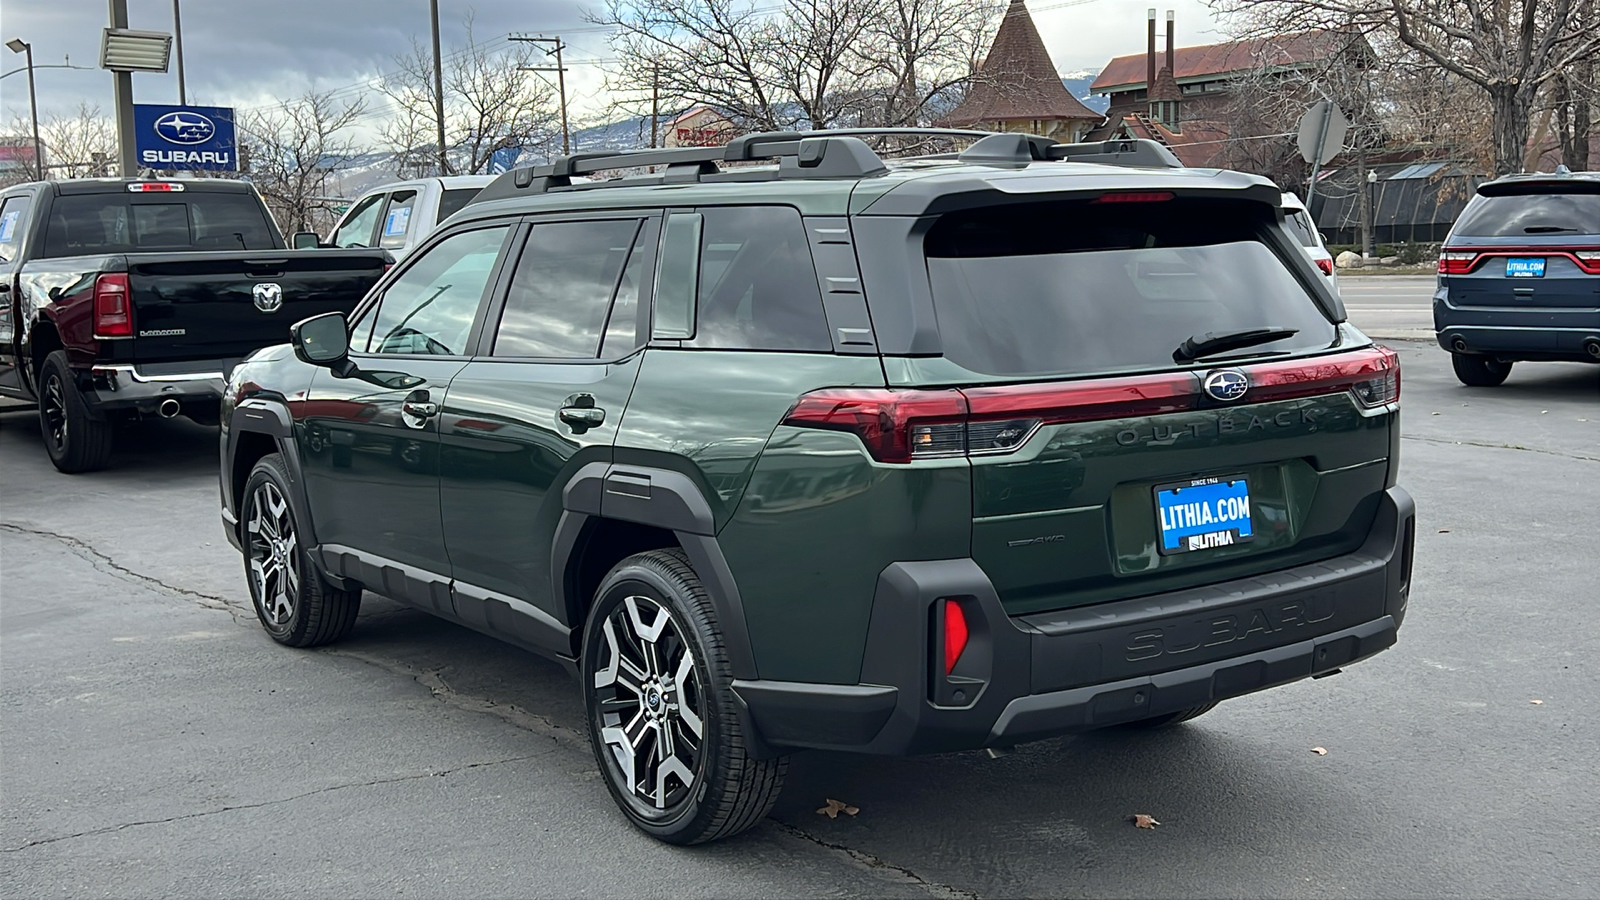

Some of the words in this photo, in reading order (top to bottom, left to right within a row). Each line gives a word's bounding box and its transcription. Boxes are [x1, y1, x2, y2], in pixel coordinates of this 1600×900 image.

[143, 150, 228, 163] SUBARU
[1507, 262, 1545, 271] LITHIA.COM
[1116, 409, 1316, 446] OUTBACK
[1191, 479, 1206, 487] SINCE
[1160, 495, 1250, 531] LITHIA.COM
[1200, 530, 1234, 550] LITHIA
[1125, 592, 1336, 662] SUBARU
